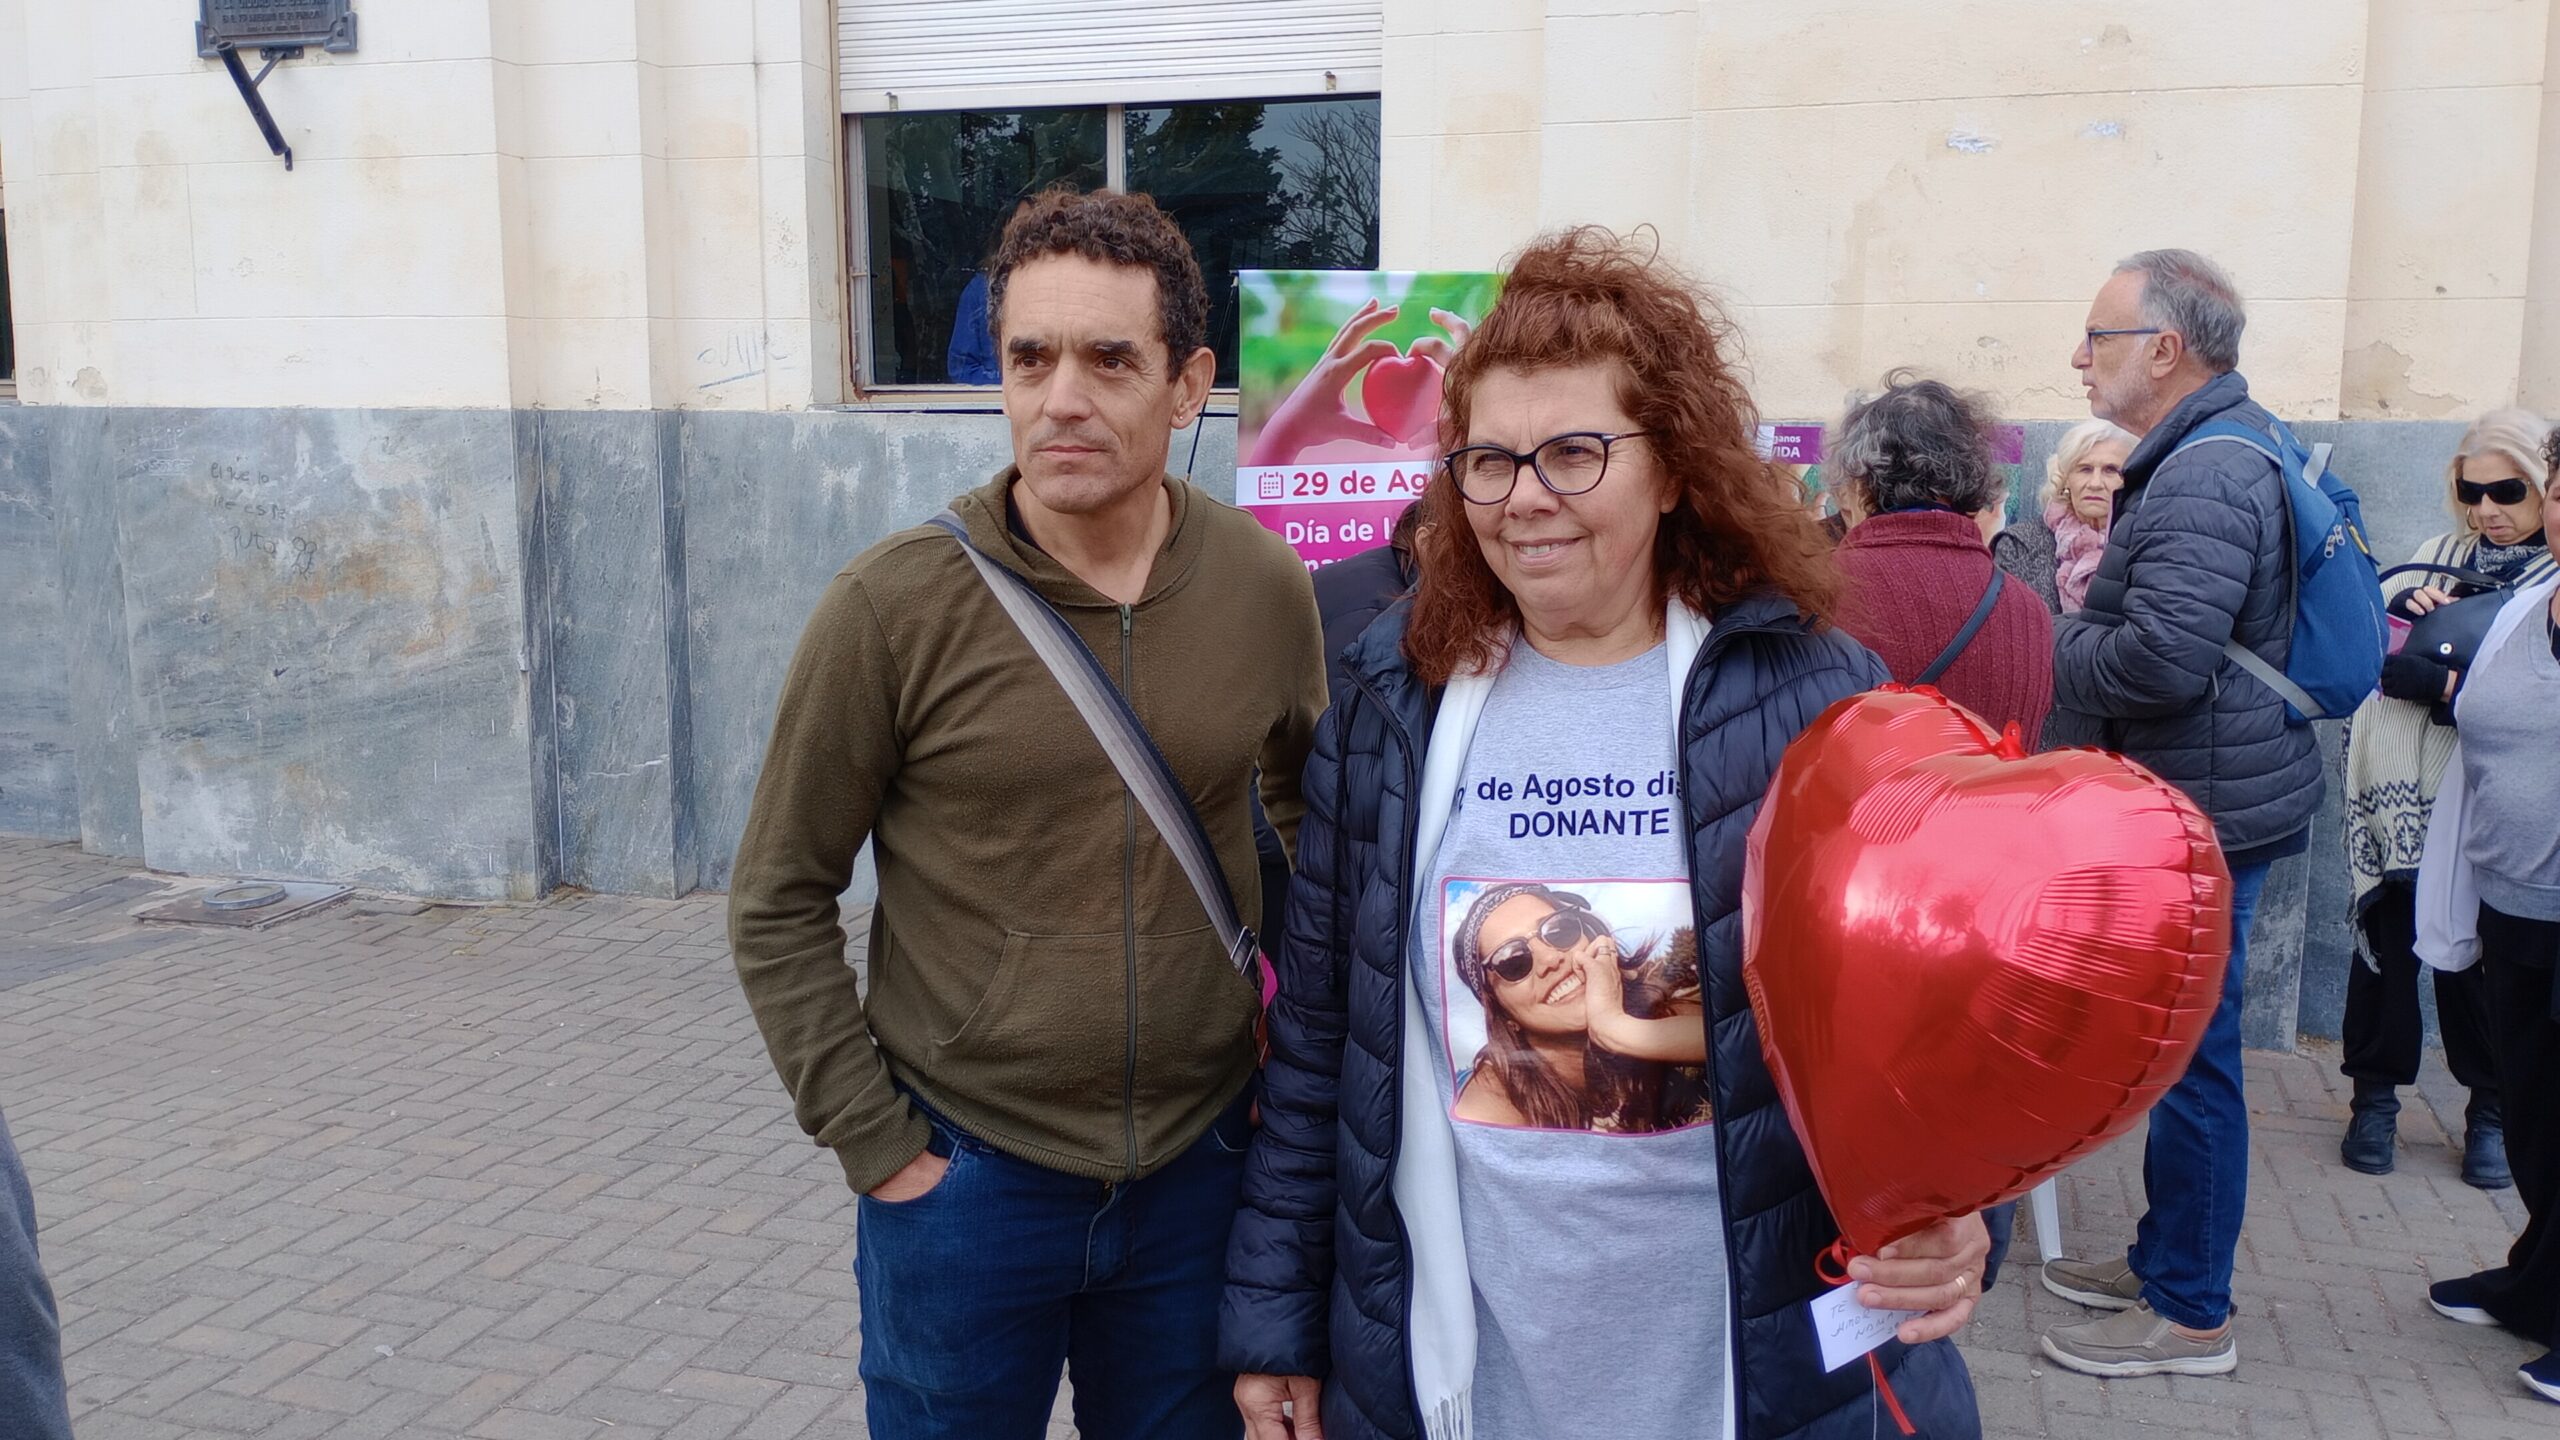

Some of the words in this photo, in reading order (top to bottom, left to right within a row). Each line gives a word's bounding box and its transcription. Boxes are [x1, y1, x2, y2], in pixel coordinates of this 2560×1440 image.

[1292, 471, 1329, 497] 29
[1339, 470, 1376, 494] de
[1285, 518, 1330, 545] Día
[1339, 517, 1374, 542] de
[1477, 777, 1513, 801] de
[1522, 773, 1635, 806] Agosto
[1509, 808, 1670, 839] DONANTE
